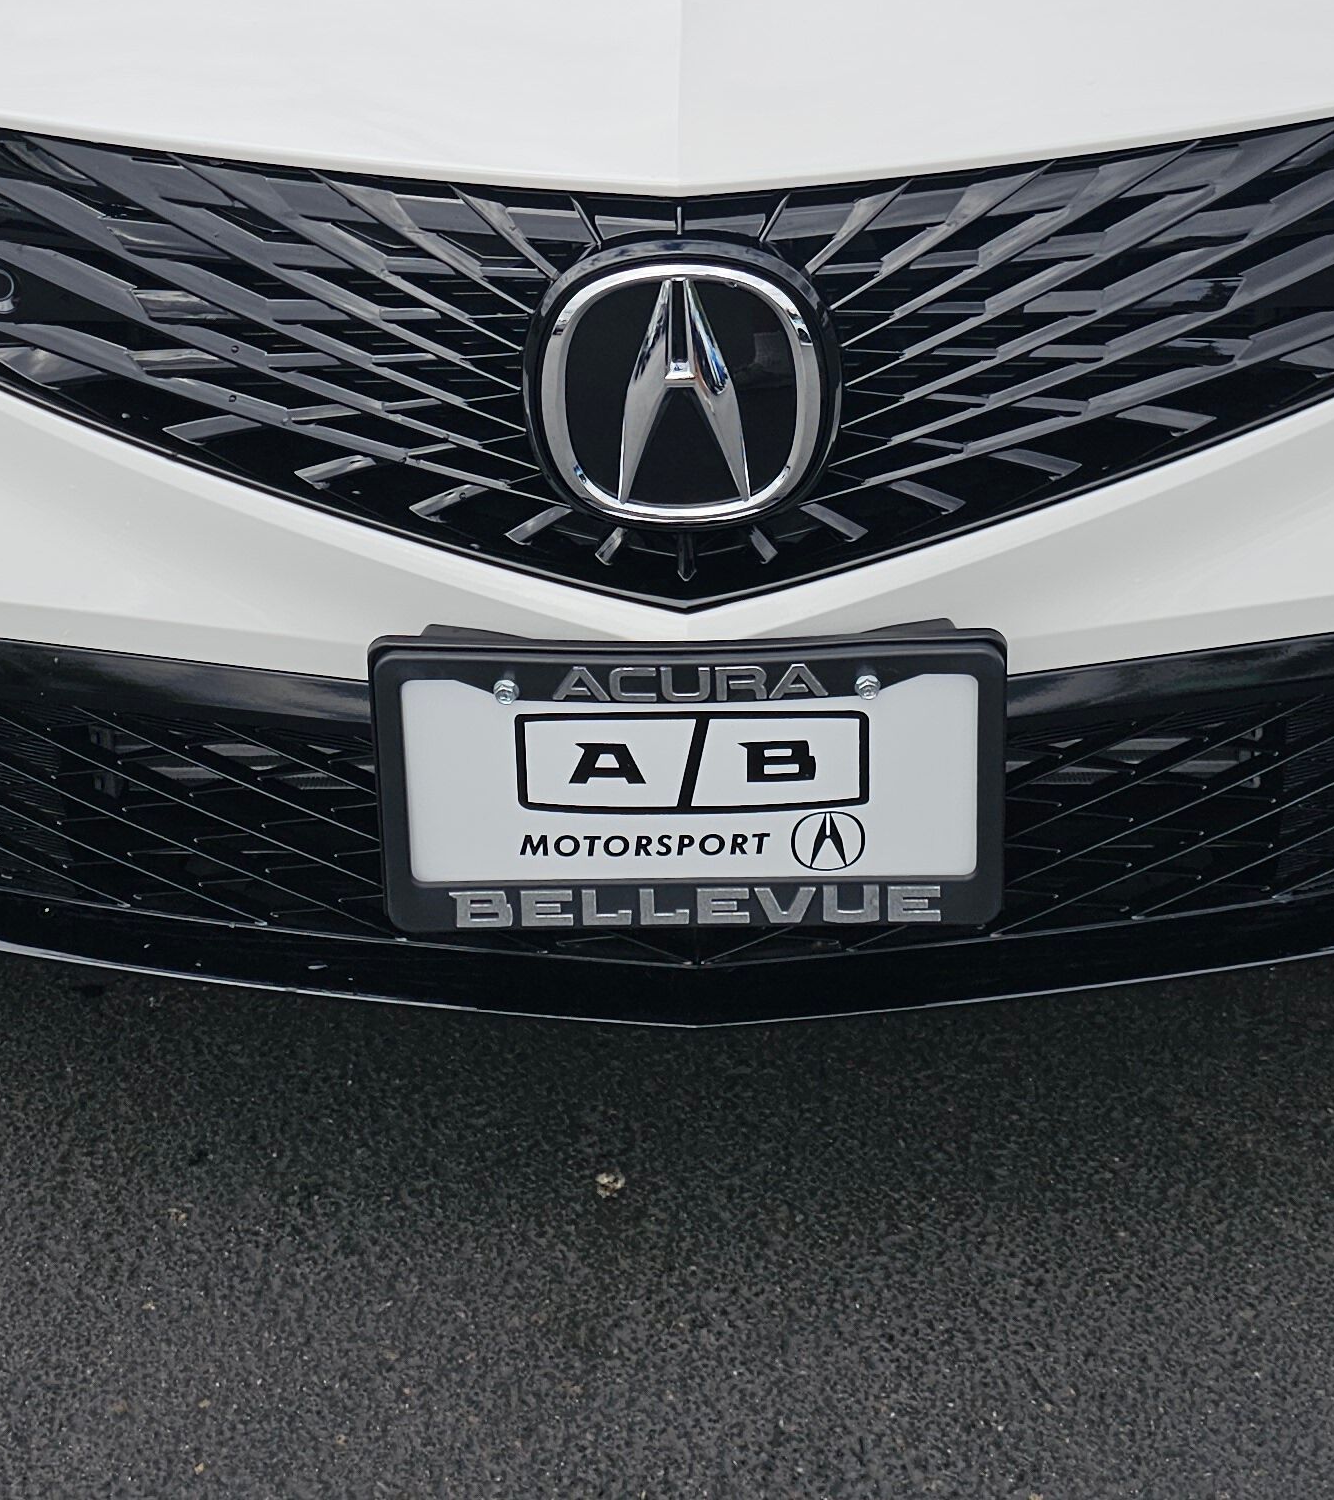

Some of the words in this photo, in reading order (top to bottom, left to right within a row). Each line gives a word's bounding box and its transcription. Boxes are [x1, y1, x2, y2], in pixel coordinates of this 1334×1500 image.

[552, 663, 829, 702] ACURA
[519, 832, 771, 857] MOTORSPORT
[449, 885, 942, 928] BELLEVUE
